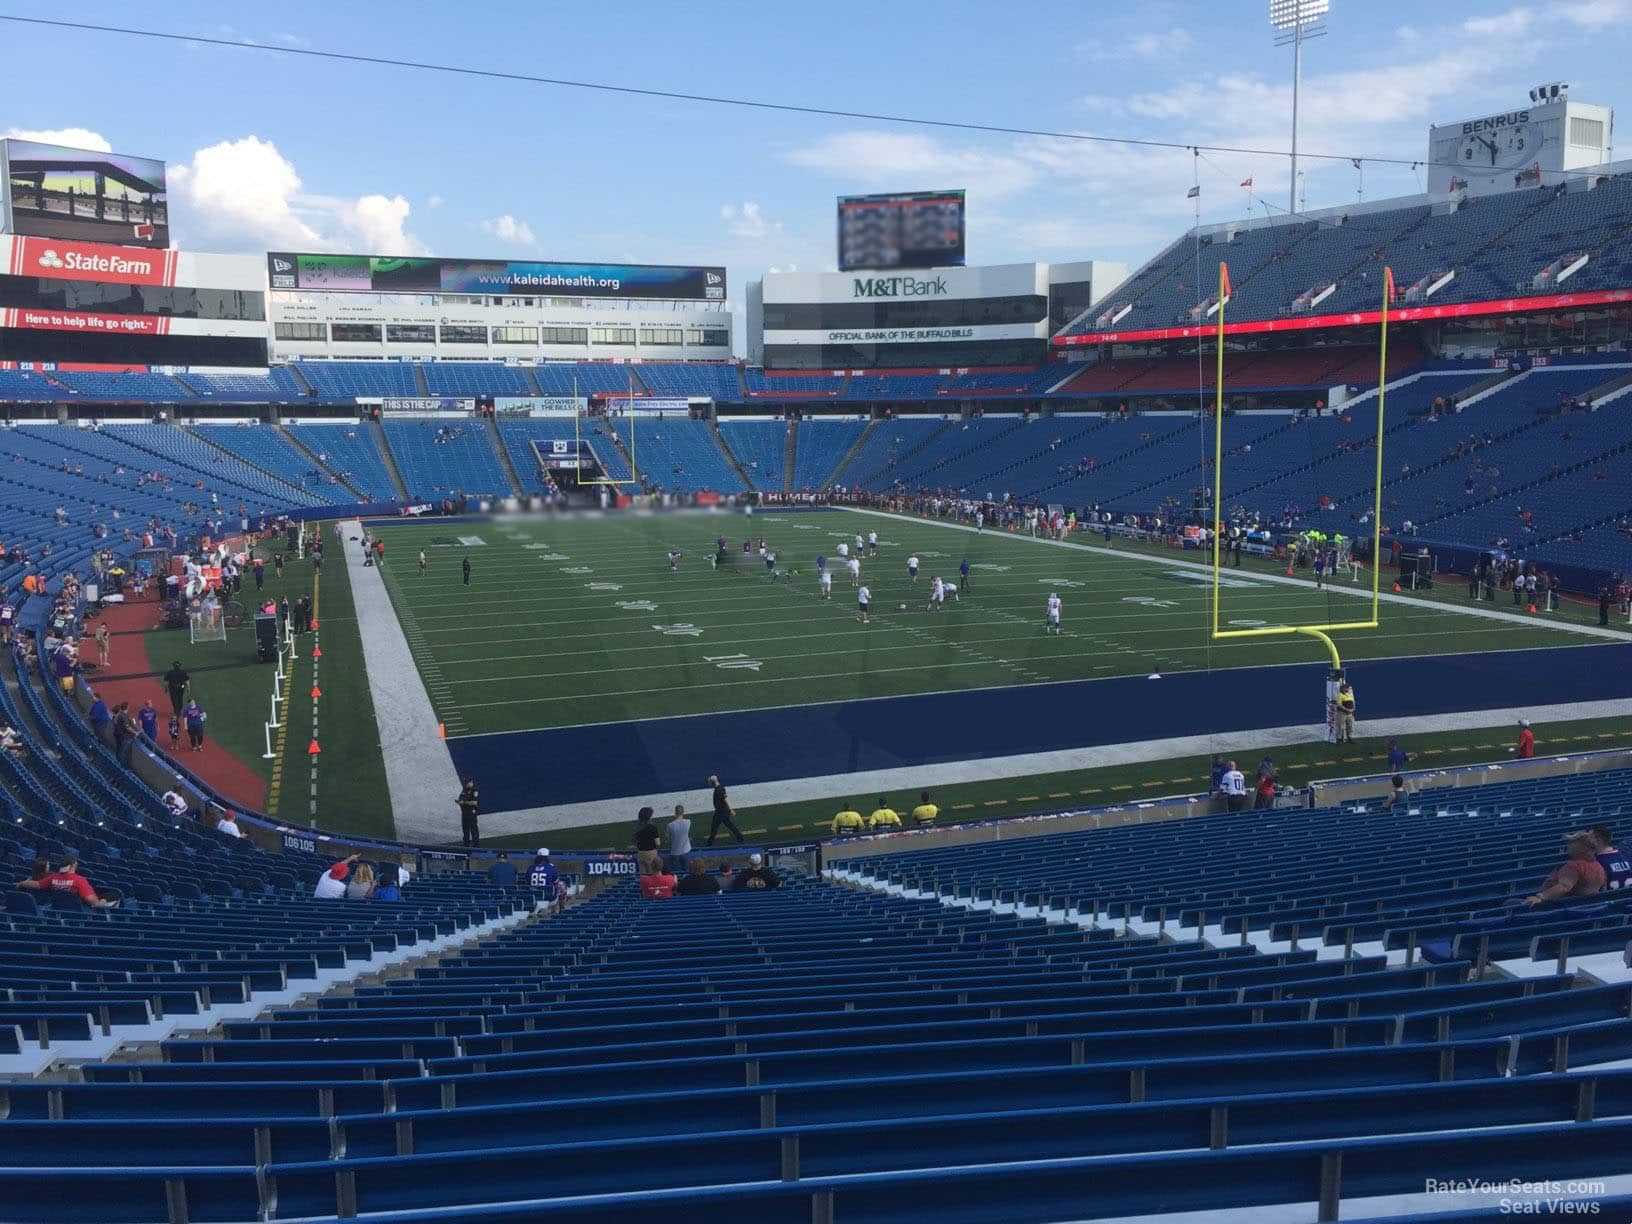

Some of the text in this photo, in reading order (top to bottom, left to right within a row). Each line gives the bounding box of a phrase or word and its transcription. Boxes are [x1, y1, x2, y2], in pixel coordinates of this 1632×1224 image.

[1462, 111, 1529, 134] BENRUS
[479, 273, 620, 290] www.kaleidahealth.org
[854, 276, 948, 298] M&T Bank
[25, 313, 49, 325] Here
[51, 315, 62, 325] to
[64, 316, 86, 328] help
[87, 317, 104, 328] life
[106, 319, 119, 330] go
[829, 329, 973, 341] OFFICIAL BANK OF THE BUFFALO BILLS
[530, 872, 547, 886] 85
